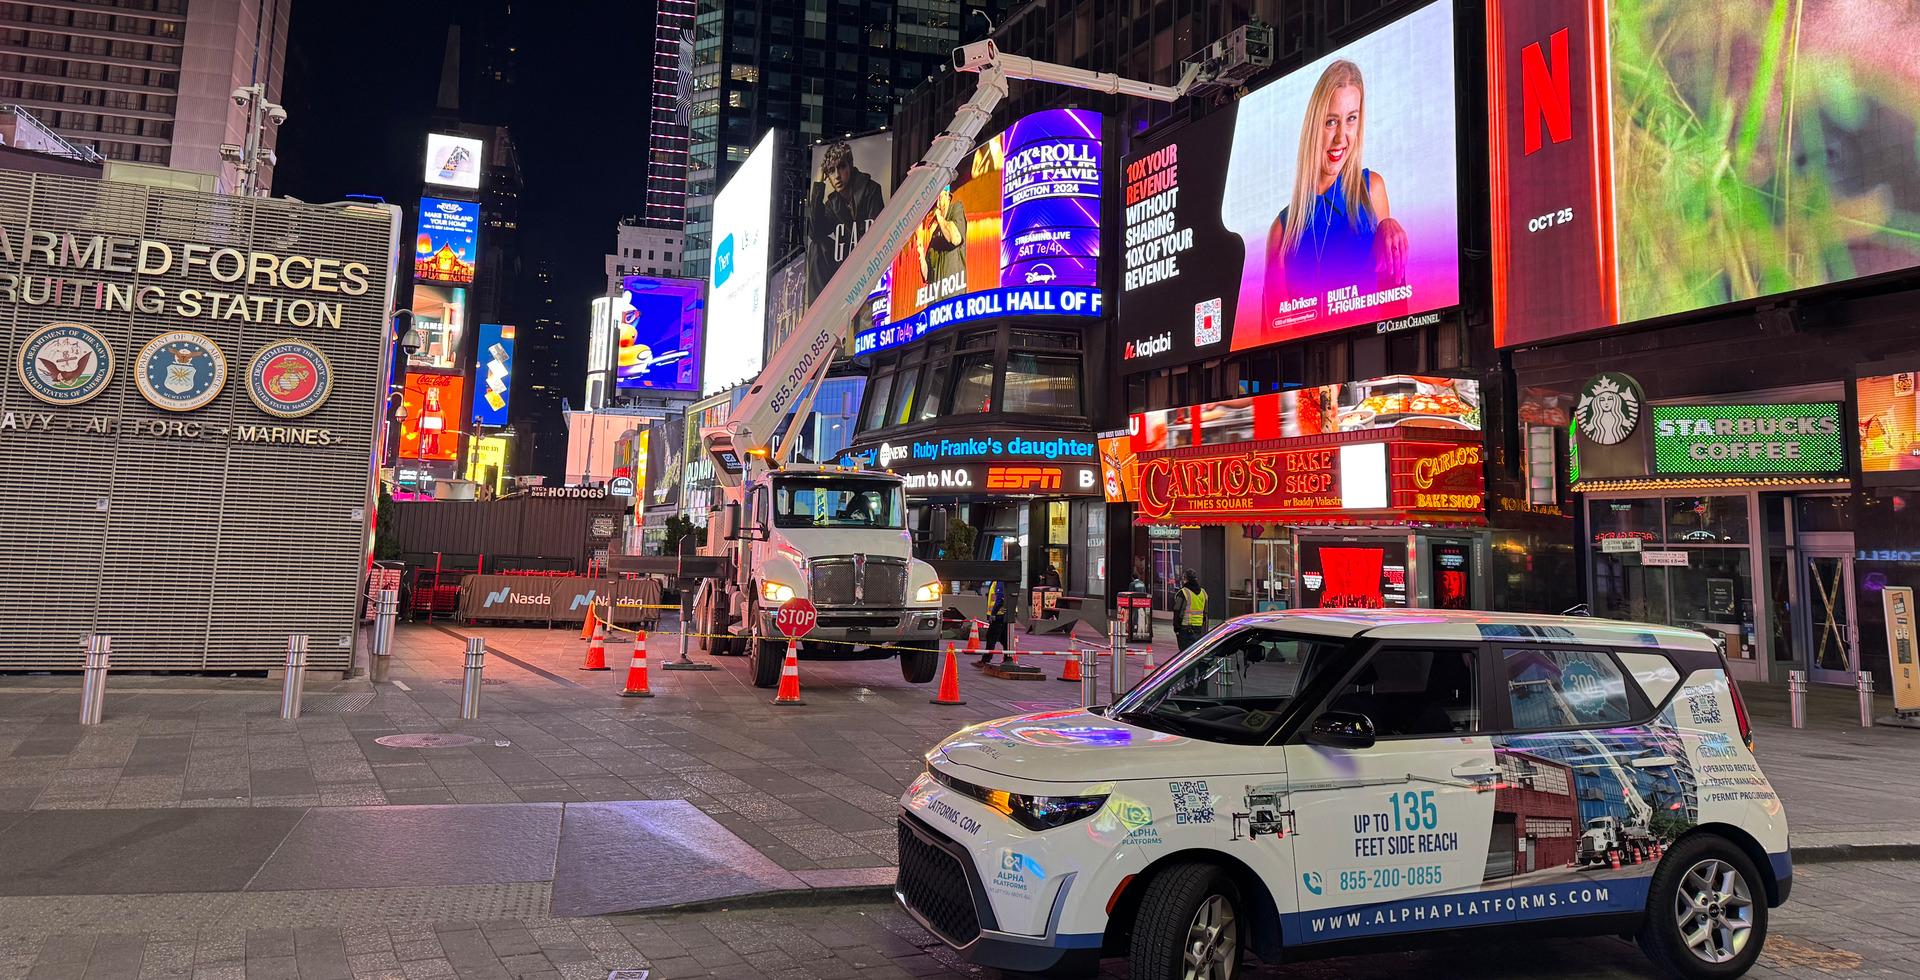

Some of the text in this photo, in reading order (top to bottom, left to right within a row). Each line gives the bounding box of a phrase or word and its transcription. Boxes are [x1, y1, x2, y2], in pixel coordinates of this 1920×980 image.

[1521, 27, 1573, 157] N
[1126, 143, 1177, 183] 10X YOUR
[1053, 184, 1079, 192] 2024
[1126, 165, 1178, 205] REVENUE
[1126, 187, 1179, 227] WITHOUT
[1126, 212, 1175, 248] SHARING
[1528, 207, 1574, 233] OCT 25
[845, 177, 938, 304] www.alphaplatforms.com
[1053, 231, 1071, 240] LIVE
[1125, 227, 1193, 269] 10X OF YOUR
[1019, 244, 1035, 257] SAT
[181, 243, 370, 296] FORCES
[1125, 256, 1180, 291] REVENUE.
[916, 280, 940, 307] JELLY
[942, 270, 966, 296] ROLL
[1327, 285, 1358, 303] BUILT A
[1327, 285, 1413, 316] 7-FIGURE BUSINESS
[176, 288, 342, 329] STATION
[861, 332, 876, 351] LIVE
[880, 328, 895, 346] SAT
[930, 303, 953, 327] ROCK
[955, 300, 964, 319] &
[966, 294, 1002, 317] ROLL
[1007, 291, 1056, 311] HALL
[1060, 291, 1087, 310] OF
[418, 321, 460, 331] SAMS
[27, 330, 66, 359] DEPARTMENT
[82, 333, 95, 345] THE
[93, 342, 107, 359] NAVY
[192, 335, 209, 346] THE
[1136, 331, 1171, 359] kajabi
[140, 337, 168, 379] DEPARTMENT
[208, 347, 220, 360] AIR
[254, 346, 293, 377] DEPARTMENT
[303, 349, 314, 359] THE
[313, 357, 325, 376] NAVY
[25, 366, 43, 390] UNITED
[43, 387, 68, 398] STATES
[82, 368, 106, 394] AMERICA
[213, 364, 223, 389] FORCE
[771, 329, 830, 413] 855.2000.855
[254, 382, 325, 410] UNITED STATES MARINE CORPS
[237, 426, 331, 446] MARINES
[1659, 415, 1836, 438] STARBUCKS
[771, 434, 804, 464] GP
[889, 446, 908, 460] NEWS
[913, 441, 939, 461] Ruby
[941, 438, 1002, 457] Franke's
[1008, 437, 1094, 458] daughter
[1690, 441, 1801, 460] COFFEE
[1286, 452, 1332, 472] BAKE
[1415, 447, 1479, 489] CARLO'S
[927, 471, 938, 487] to
[942, 469, 972, 487] N.O.
[987, 467, 1063, 490] ESPN
[1139, 451, 1279, 518] CARLO'S
[1285, 474, 1332, 494] SHOP
[549, 487, 604, 498] HOTDOGS
[1188, 498, 1253, 509] TIMES SQUARE
[1292, 497, 1315, 508] Buddy
[1416, 493, 1480, 508] BAKE SHOP
[509, 592, 551, 605] Nasda
[779, 609, 815, 626] STOP
[1703, 764, 1756, 773] OPERATED RENTALS
[1709, 778, 1733, 786] TRAFFIC
[1712, 792, 1775, 802] PERMIT PROCUREMENT
[1354, 813, 1389, 834] UP TO
[1389, 790, 1438, 832] 135
[1122, 837, 1162, 845] PLATFORMS
[1355, 832, 1458, 858] FEET SIDE REACH
[993, 879, 1027, 890] PLATFORMS
[998, 871, 1024, 883] ALPHA
[1340, 865, 1442, 891] 855-200-0855
[1312, 887, 1609, 933] WWW.ALPHAPLATFORMS.COM
